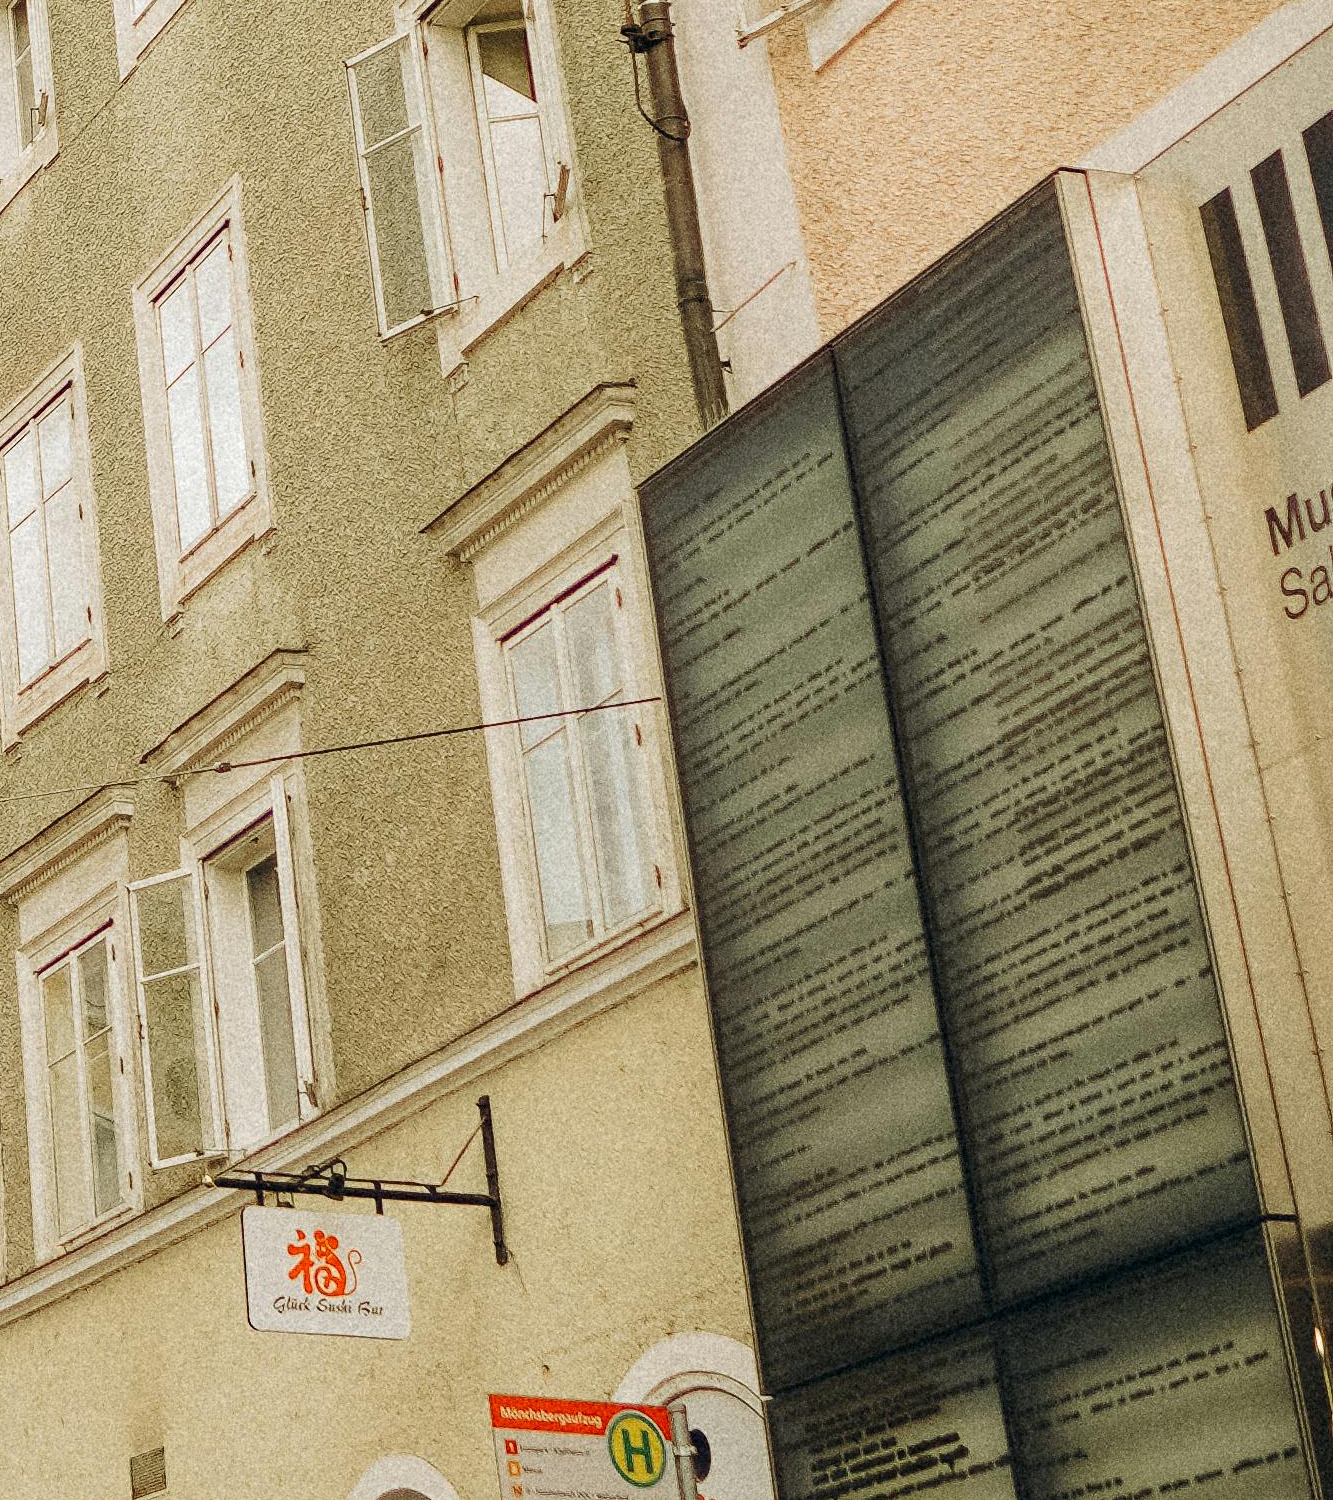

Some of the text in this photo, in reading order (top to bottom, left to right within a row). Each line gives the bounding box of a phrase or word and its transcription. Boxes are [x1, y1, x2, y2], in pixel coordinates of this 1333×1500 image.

[1265, 484, 1333, 556] Mu
[272, 1296, 384, 1317] Glück Sushi Bar
[499, 1404, 603, 1430] Mönchsbergaufzug
[621, 1428, 656, 1475] H
